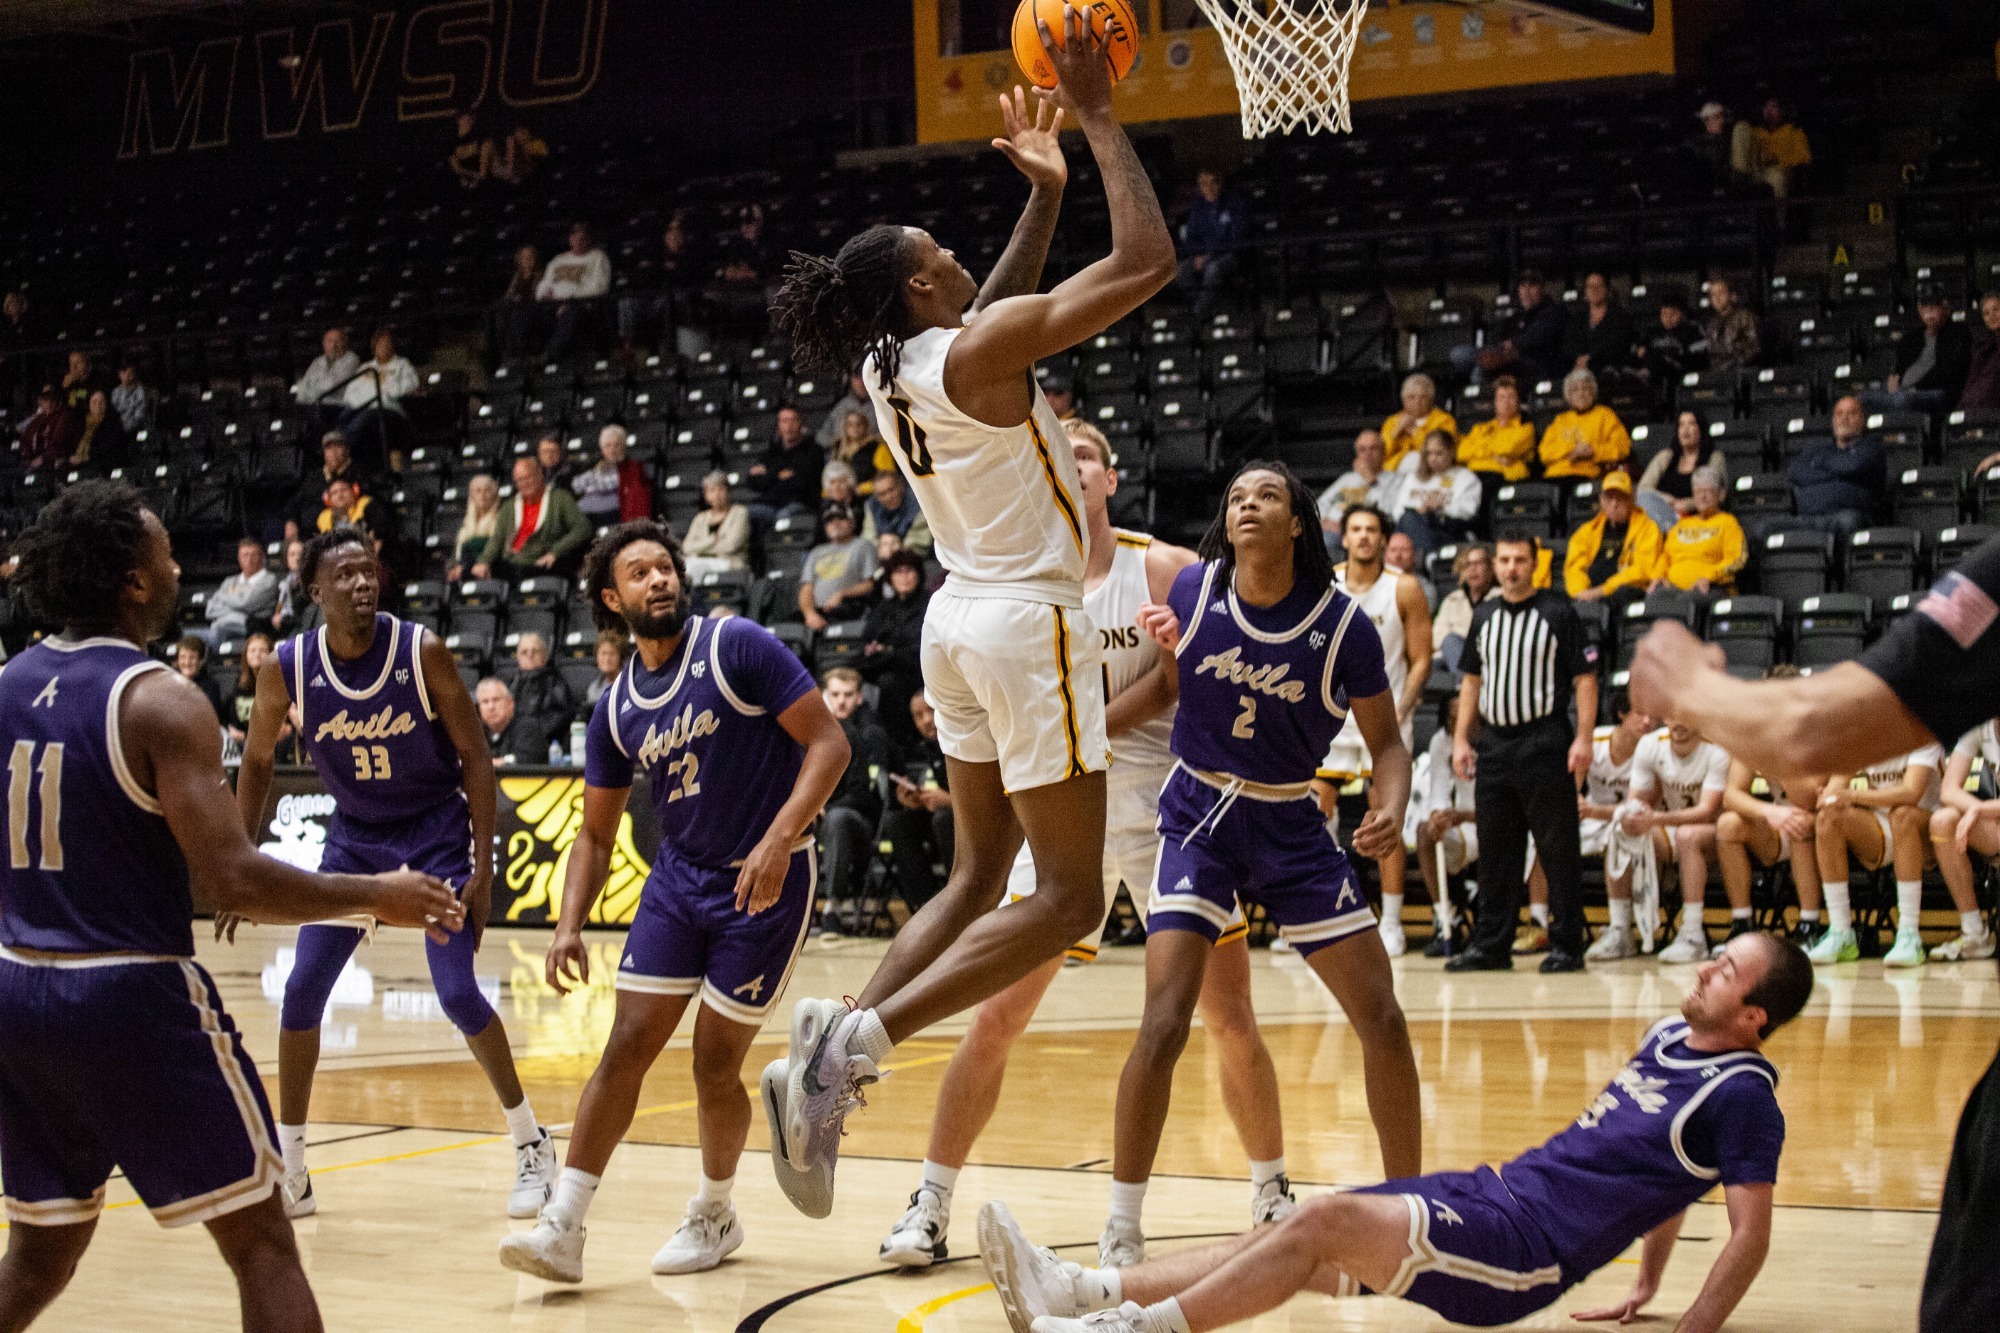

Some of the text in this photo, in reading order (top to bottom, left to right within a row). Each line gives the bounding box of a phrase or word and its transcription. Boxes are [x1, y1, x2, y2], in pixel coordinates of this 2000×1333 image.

[116, 0, 609, 160] MWSU
[1833, 244, 1849, 266] A
[887, 397, 935, 477] 0
[1195, 645, 1306, 703] Avila
[315, 704, 417, 742] Avila
[638, 702, 720, 770] Avila
[1232, 694, 1257, 739] 2
[351, 745, 392, 780] 33
[7, 740, 65, 871] 11
